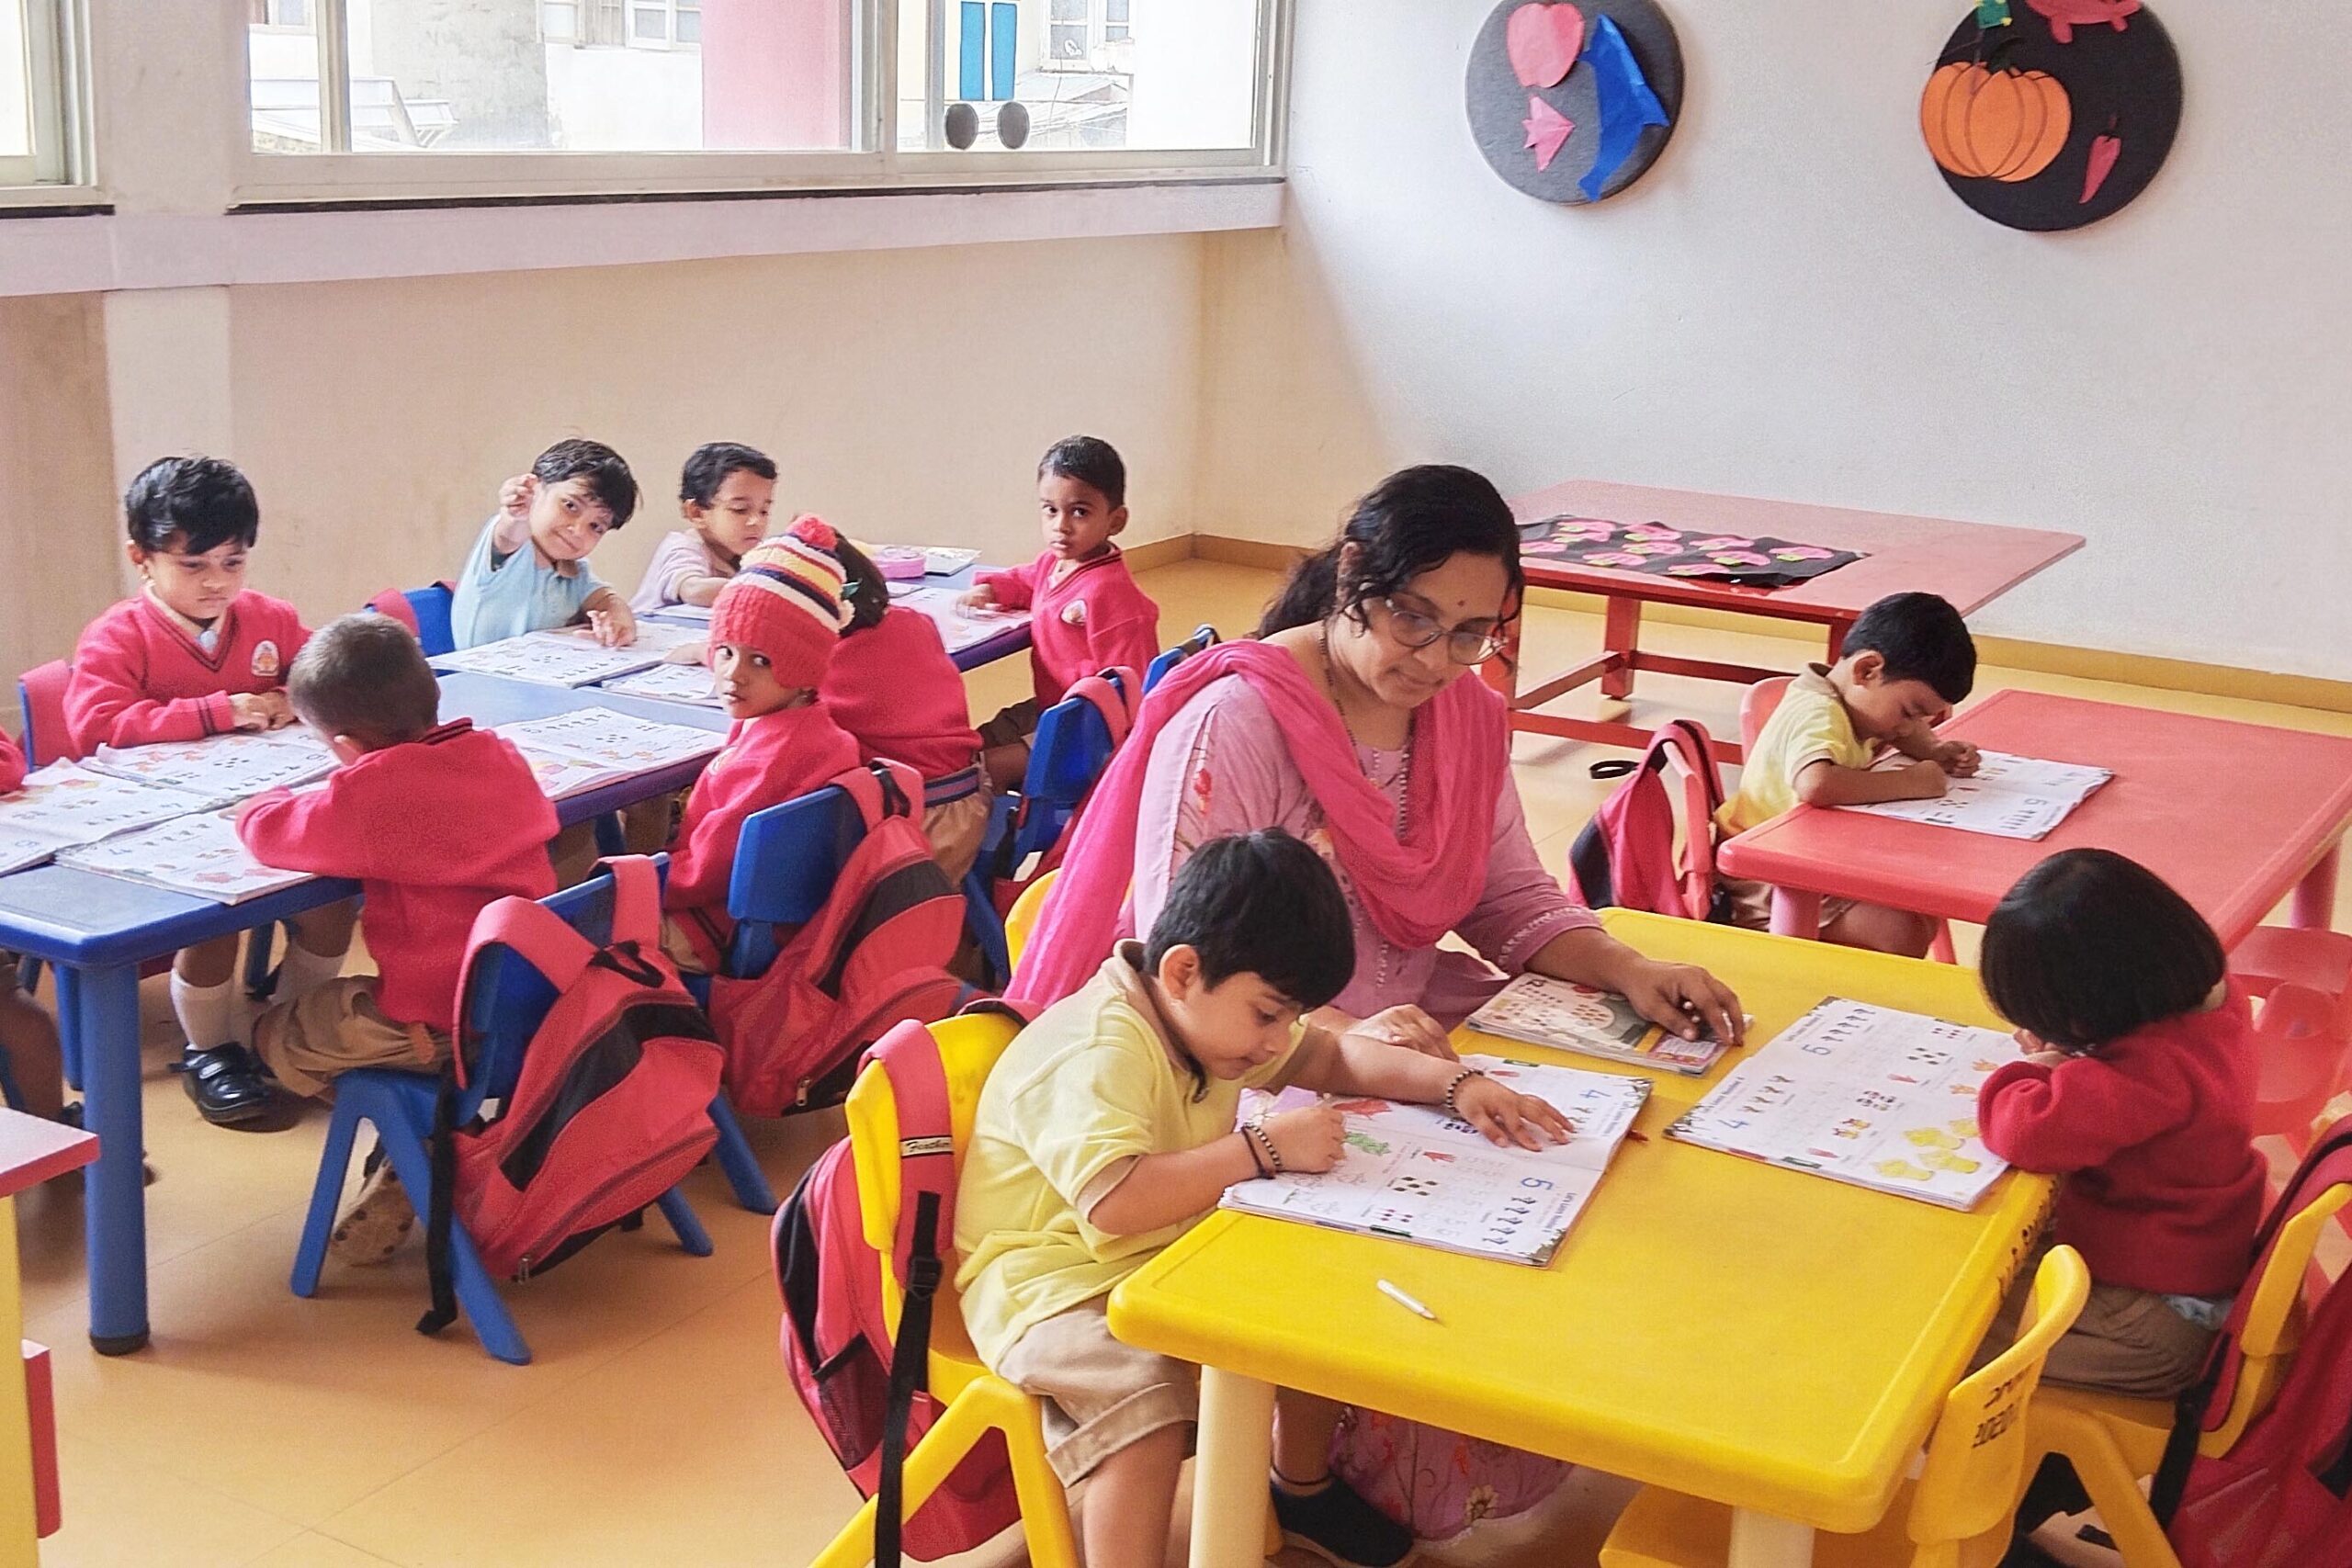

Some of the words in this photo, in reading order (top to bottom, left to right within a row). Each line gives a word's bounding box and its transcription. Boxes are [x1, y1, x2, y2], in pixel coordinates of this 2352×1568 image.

[2024, 798, 2049, 807] 5
[1802, 1043, 1831, 1055] 5
[1578, 1089, 1612, 1100] 4
[1717, 1118, 1750, 1129] 4
[1521, 1177, 1555, 1190] 5
